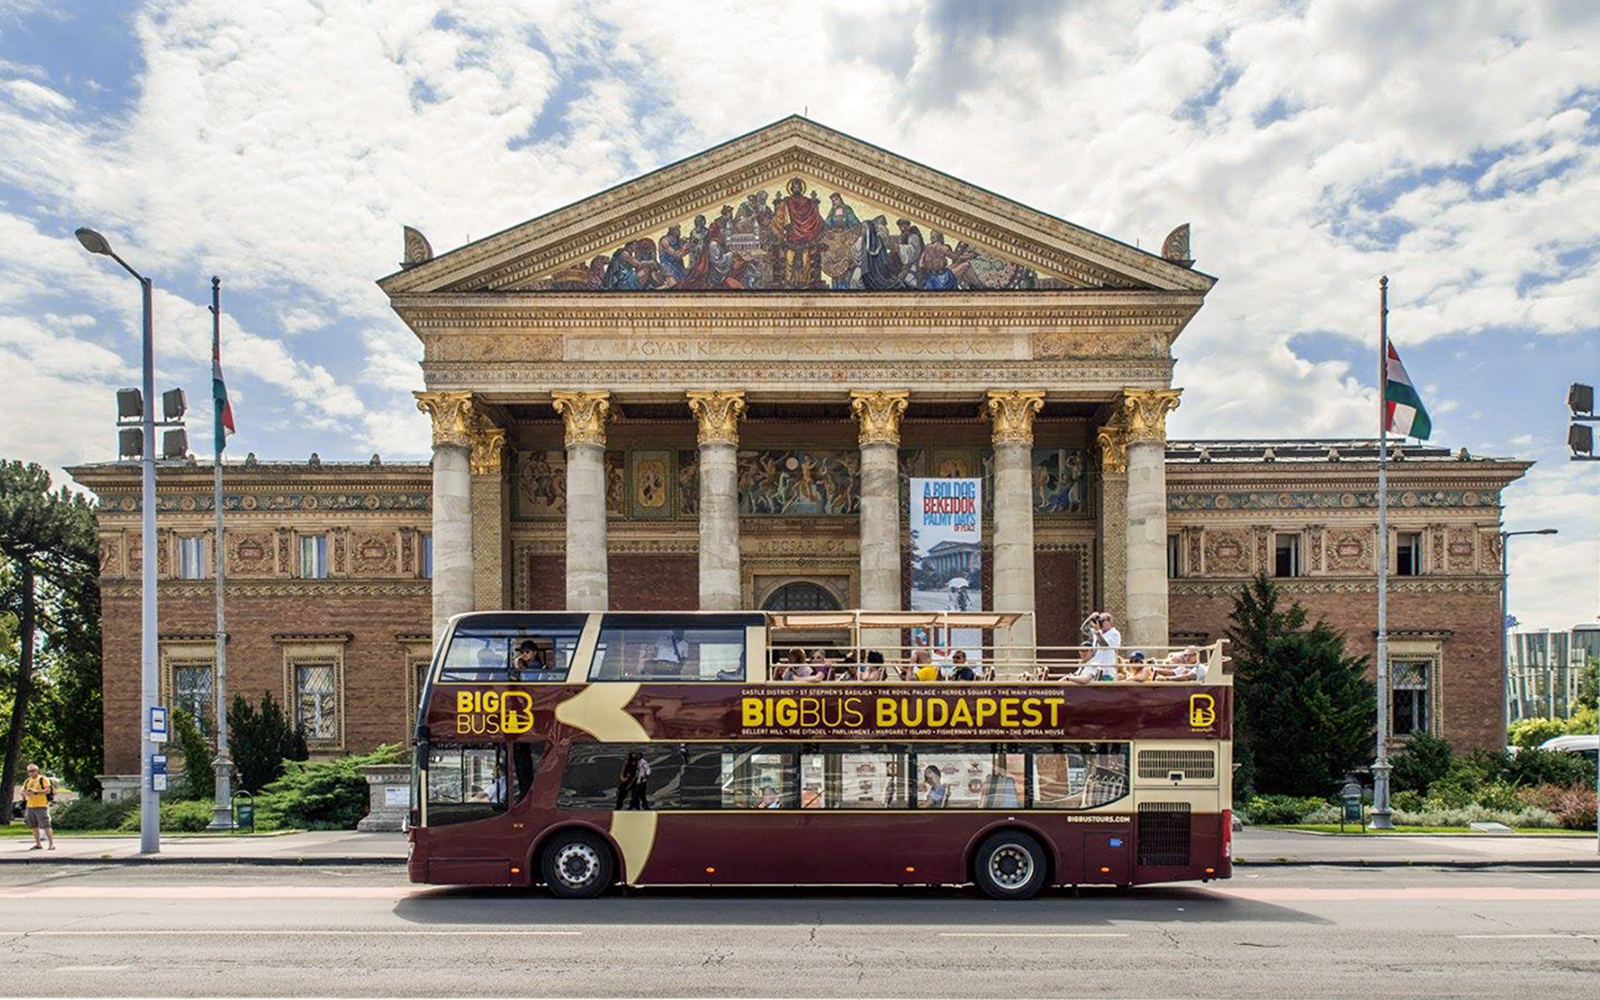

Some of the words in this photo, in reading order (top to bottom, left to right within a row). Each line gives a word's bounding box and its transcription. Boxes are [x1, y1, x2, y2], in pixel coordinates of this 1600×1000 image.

[923, 481, 931, 497] A
[933, 481, 976, 497] BOLDOG
[923, 513, 952, 526] PALMY
[457, 690, 500, 713] BIG
[876, 698, 1065, 727] BUDAPEST
[457, 714, 500, 734] BUS
